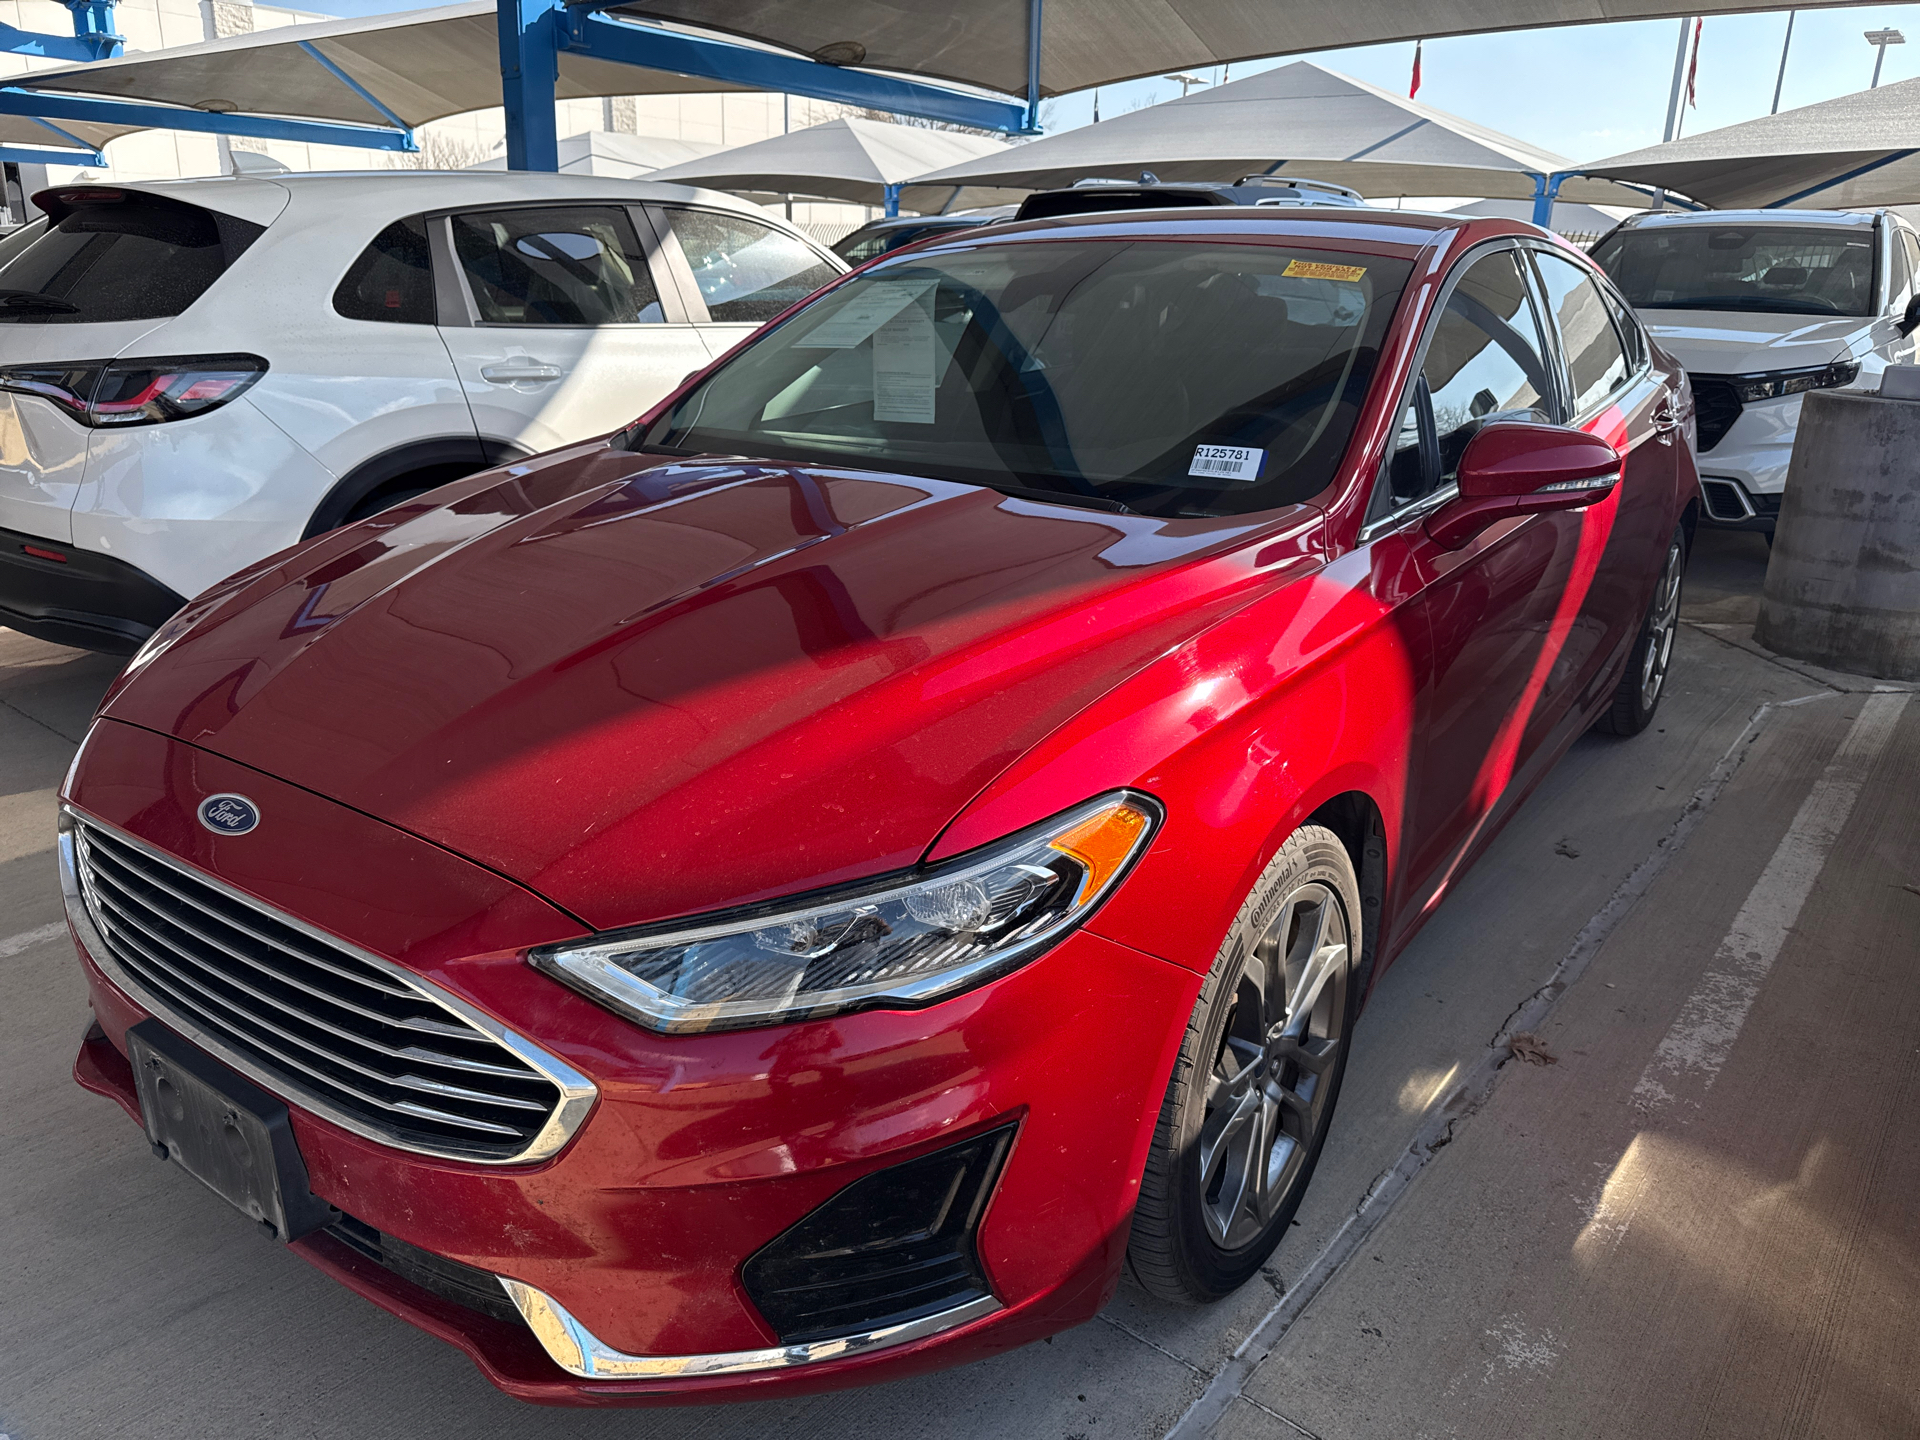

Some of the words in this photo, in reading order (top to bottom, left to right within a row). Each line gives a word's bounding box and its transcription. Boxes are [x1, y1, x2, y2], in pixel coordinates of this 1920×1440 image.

[1195, 447, 1250, 461] R125781
[208, 800, 247, 827] Ford
[1250, 862, 1293, 929] Continental
